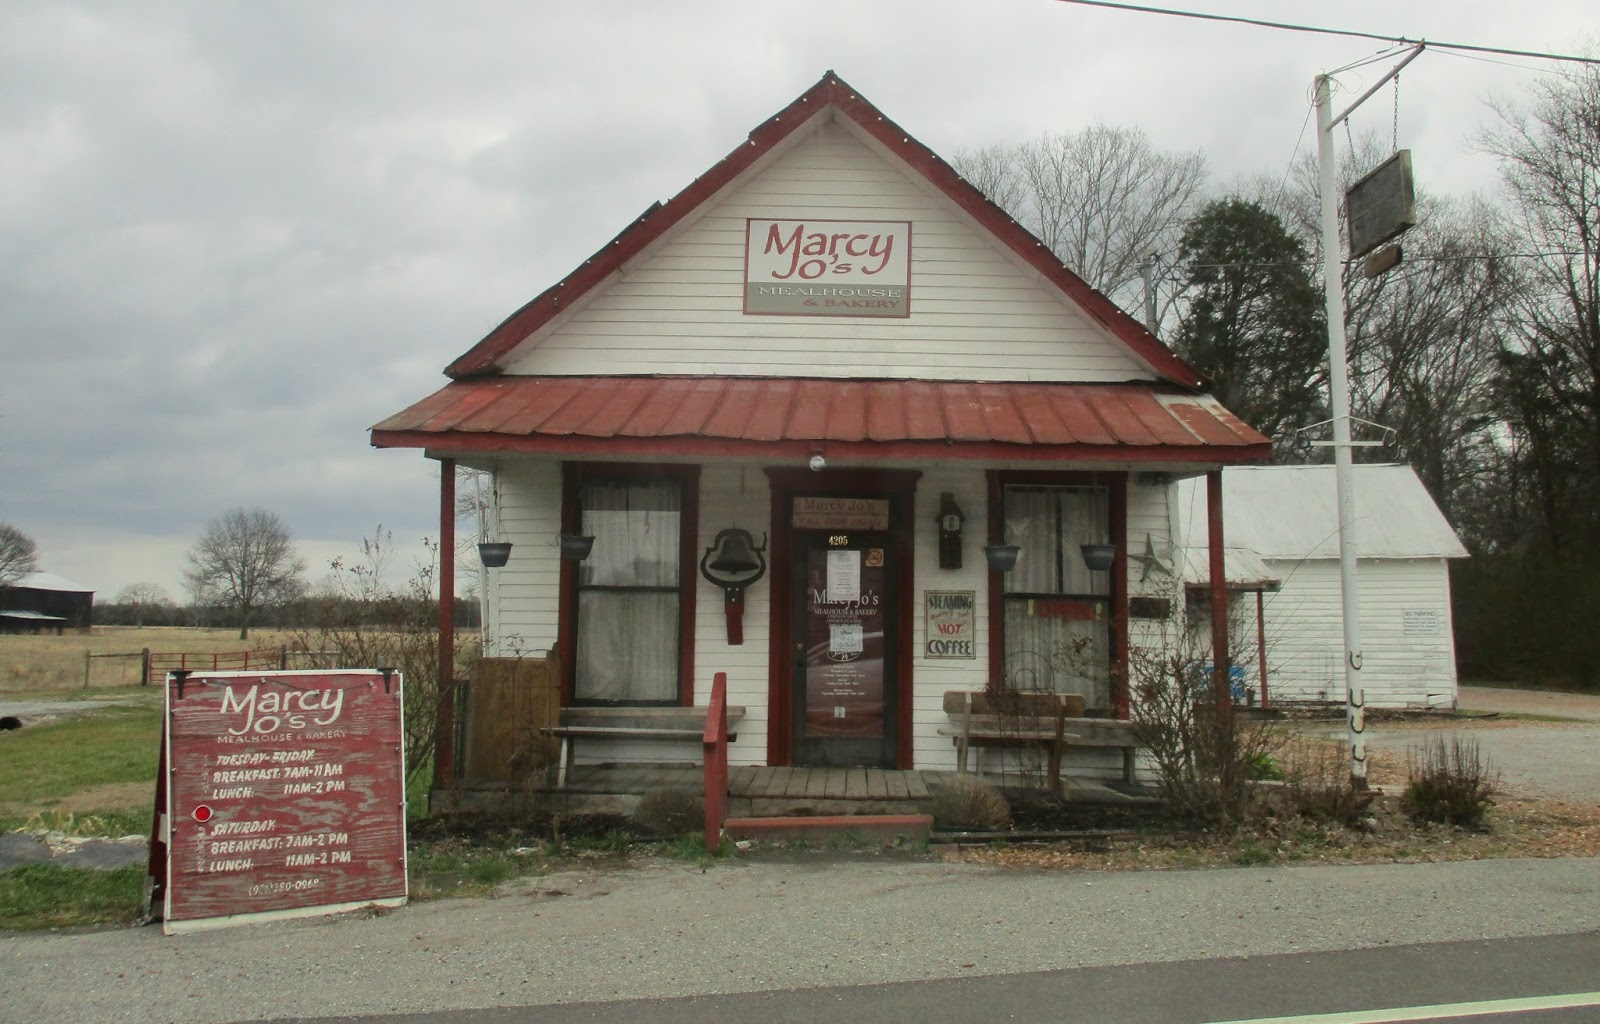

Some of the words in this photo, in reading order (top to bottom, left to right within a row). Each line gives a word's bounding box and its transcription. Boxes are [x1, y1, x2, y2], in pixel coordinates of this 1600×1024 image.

[764, 223, 894, 275] Marcy
[758, 287, 901, 298] MEALHOUSE
[803, 299, 818, 307] &
[825, 299, 900, 309] BAKERY
[828, 535, 849, 546] 4205
[937, 623, 963, 635] HOT
[928, 639, 973, 655] COFFEE
[220, 685, 344, 725] Marcy
[217, 733, 292, 744] MEALHOUSE
[306, 730, 347, 739] BAKERY
[213, 767, 281, 783] BREAKFAST:
[210, 837, 283, 854] BREAKFAST:
[328, 832, 348, 846] PM
[331, 850, 351, 864] PM
